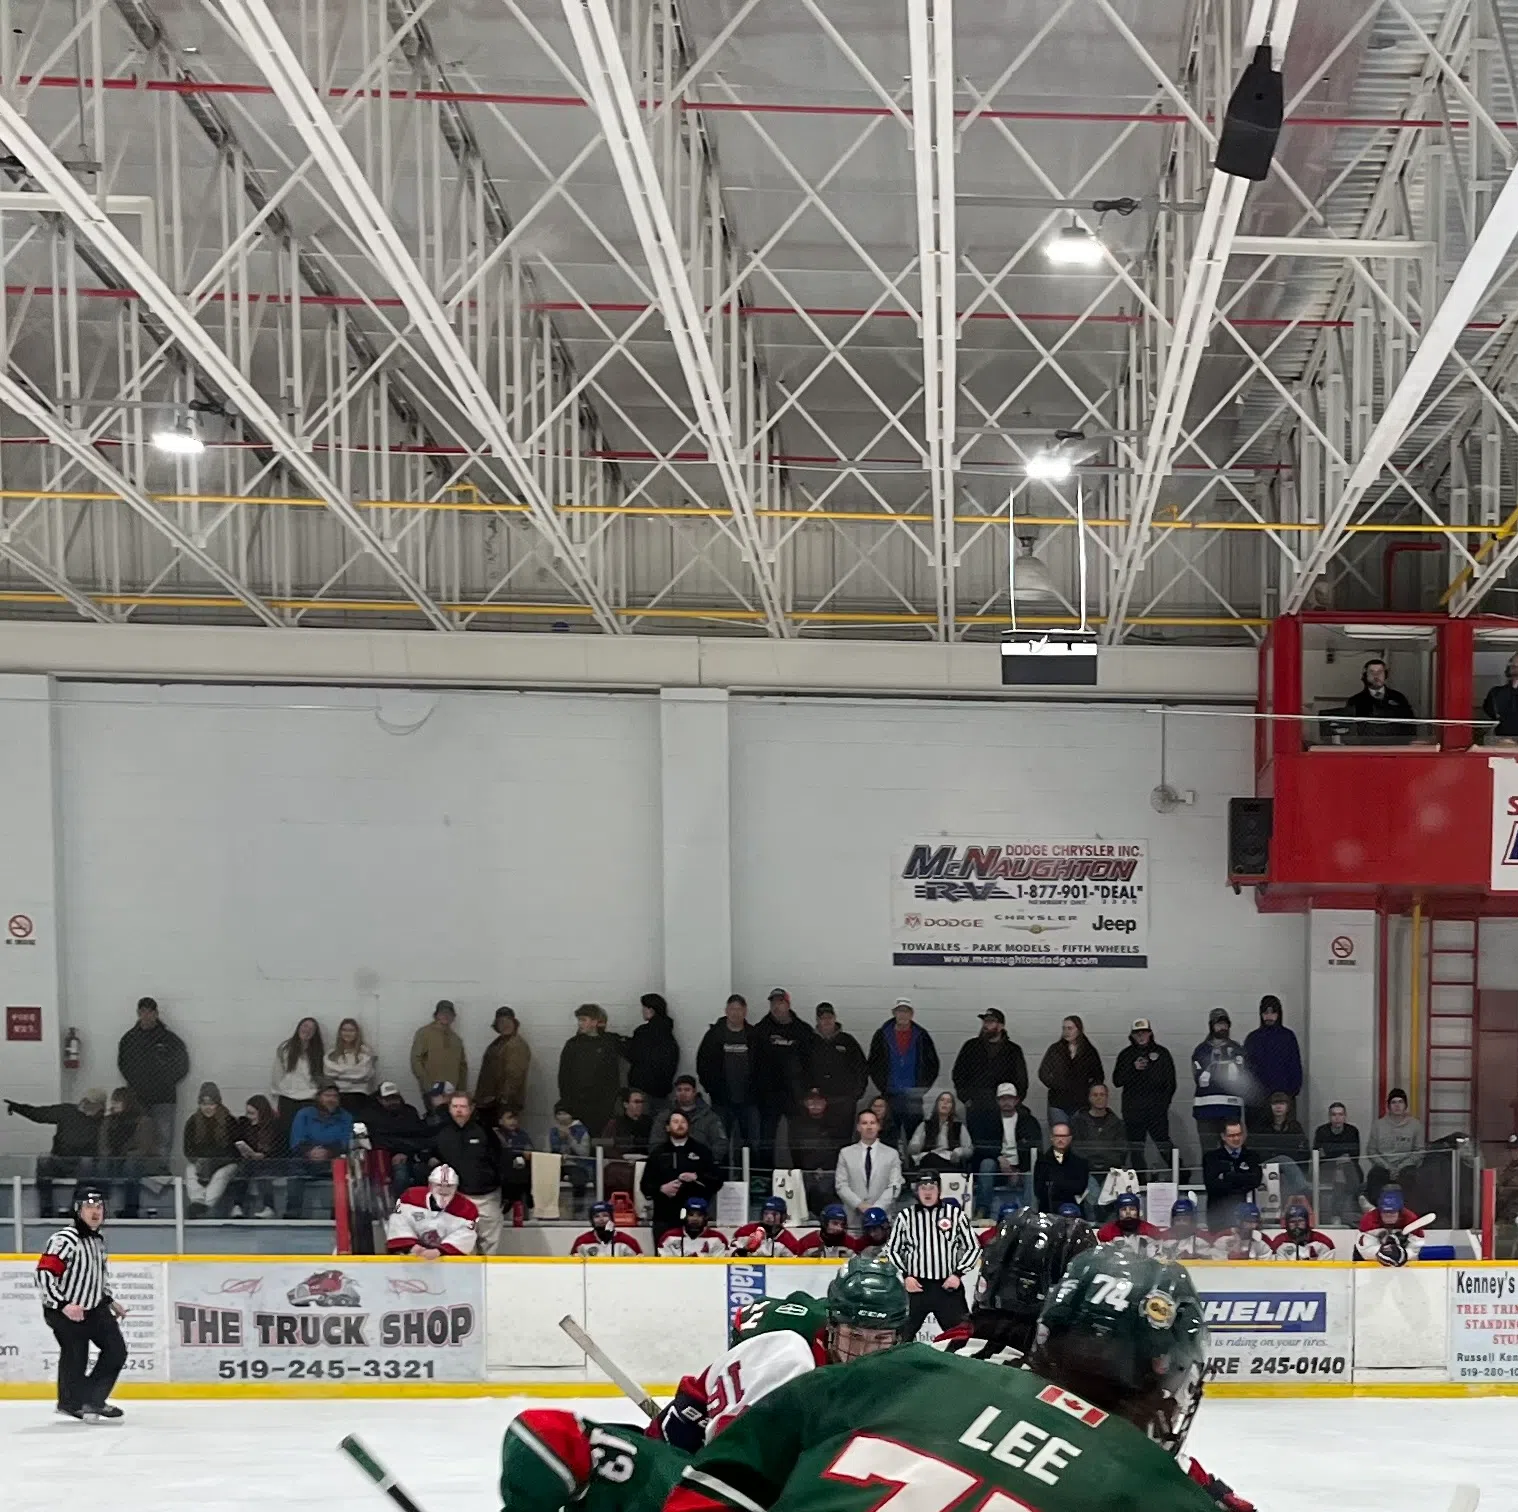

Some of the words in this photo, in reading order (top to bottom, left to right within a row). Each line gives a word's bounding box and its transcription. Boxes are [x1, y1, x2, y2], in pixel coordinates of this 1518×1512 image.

[1006, 845, 1048, 856] DODGE
[1052, 845, 1114, 857] CHRYSLER
[1118, 846, 1144, 857] INC.
[924, 918, 984, 928] DODGE
[1092, 915, 1137, 934] Jeep
[902, 943, 960, 952] TOWABLES
[972, 944, 1000, 952] PARK
[1005, 944, 1050, 953] MODELS
[1063, 945, 1092, 953] FIFTH
[1095, 945, 1140, 953] WHEELS
[943, 955, 1098, 967] www.mcnaughtondodge.com
[1457, 1271, 1515, 1298] Kenney's
[1090, 1273, 1134, 1312] 74
[858, 1309, 888, 1319] CCM
[1200, 1301, 1318, 1321] HELIN
[1457, 1305, 1487, 1314] TREE
[177, 1303, 242, 1346] THE
[254, 1313, 369, 1346] TRUCK
[381, 1304, 474, 1346] SHOP
[1274, 1340, 1301, 1349] your
[1457, 1353, 1494, 1362] Russell
[219, 1360, 434, 1378] 519-245-3321
[1250, 1357, 1345, 1374] 245-0140
[959, 1405, 1083, 1486] LEE
